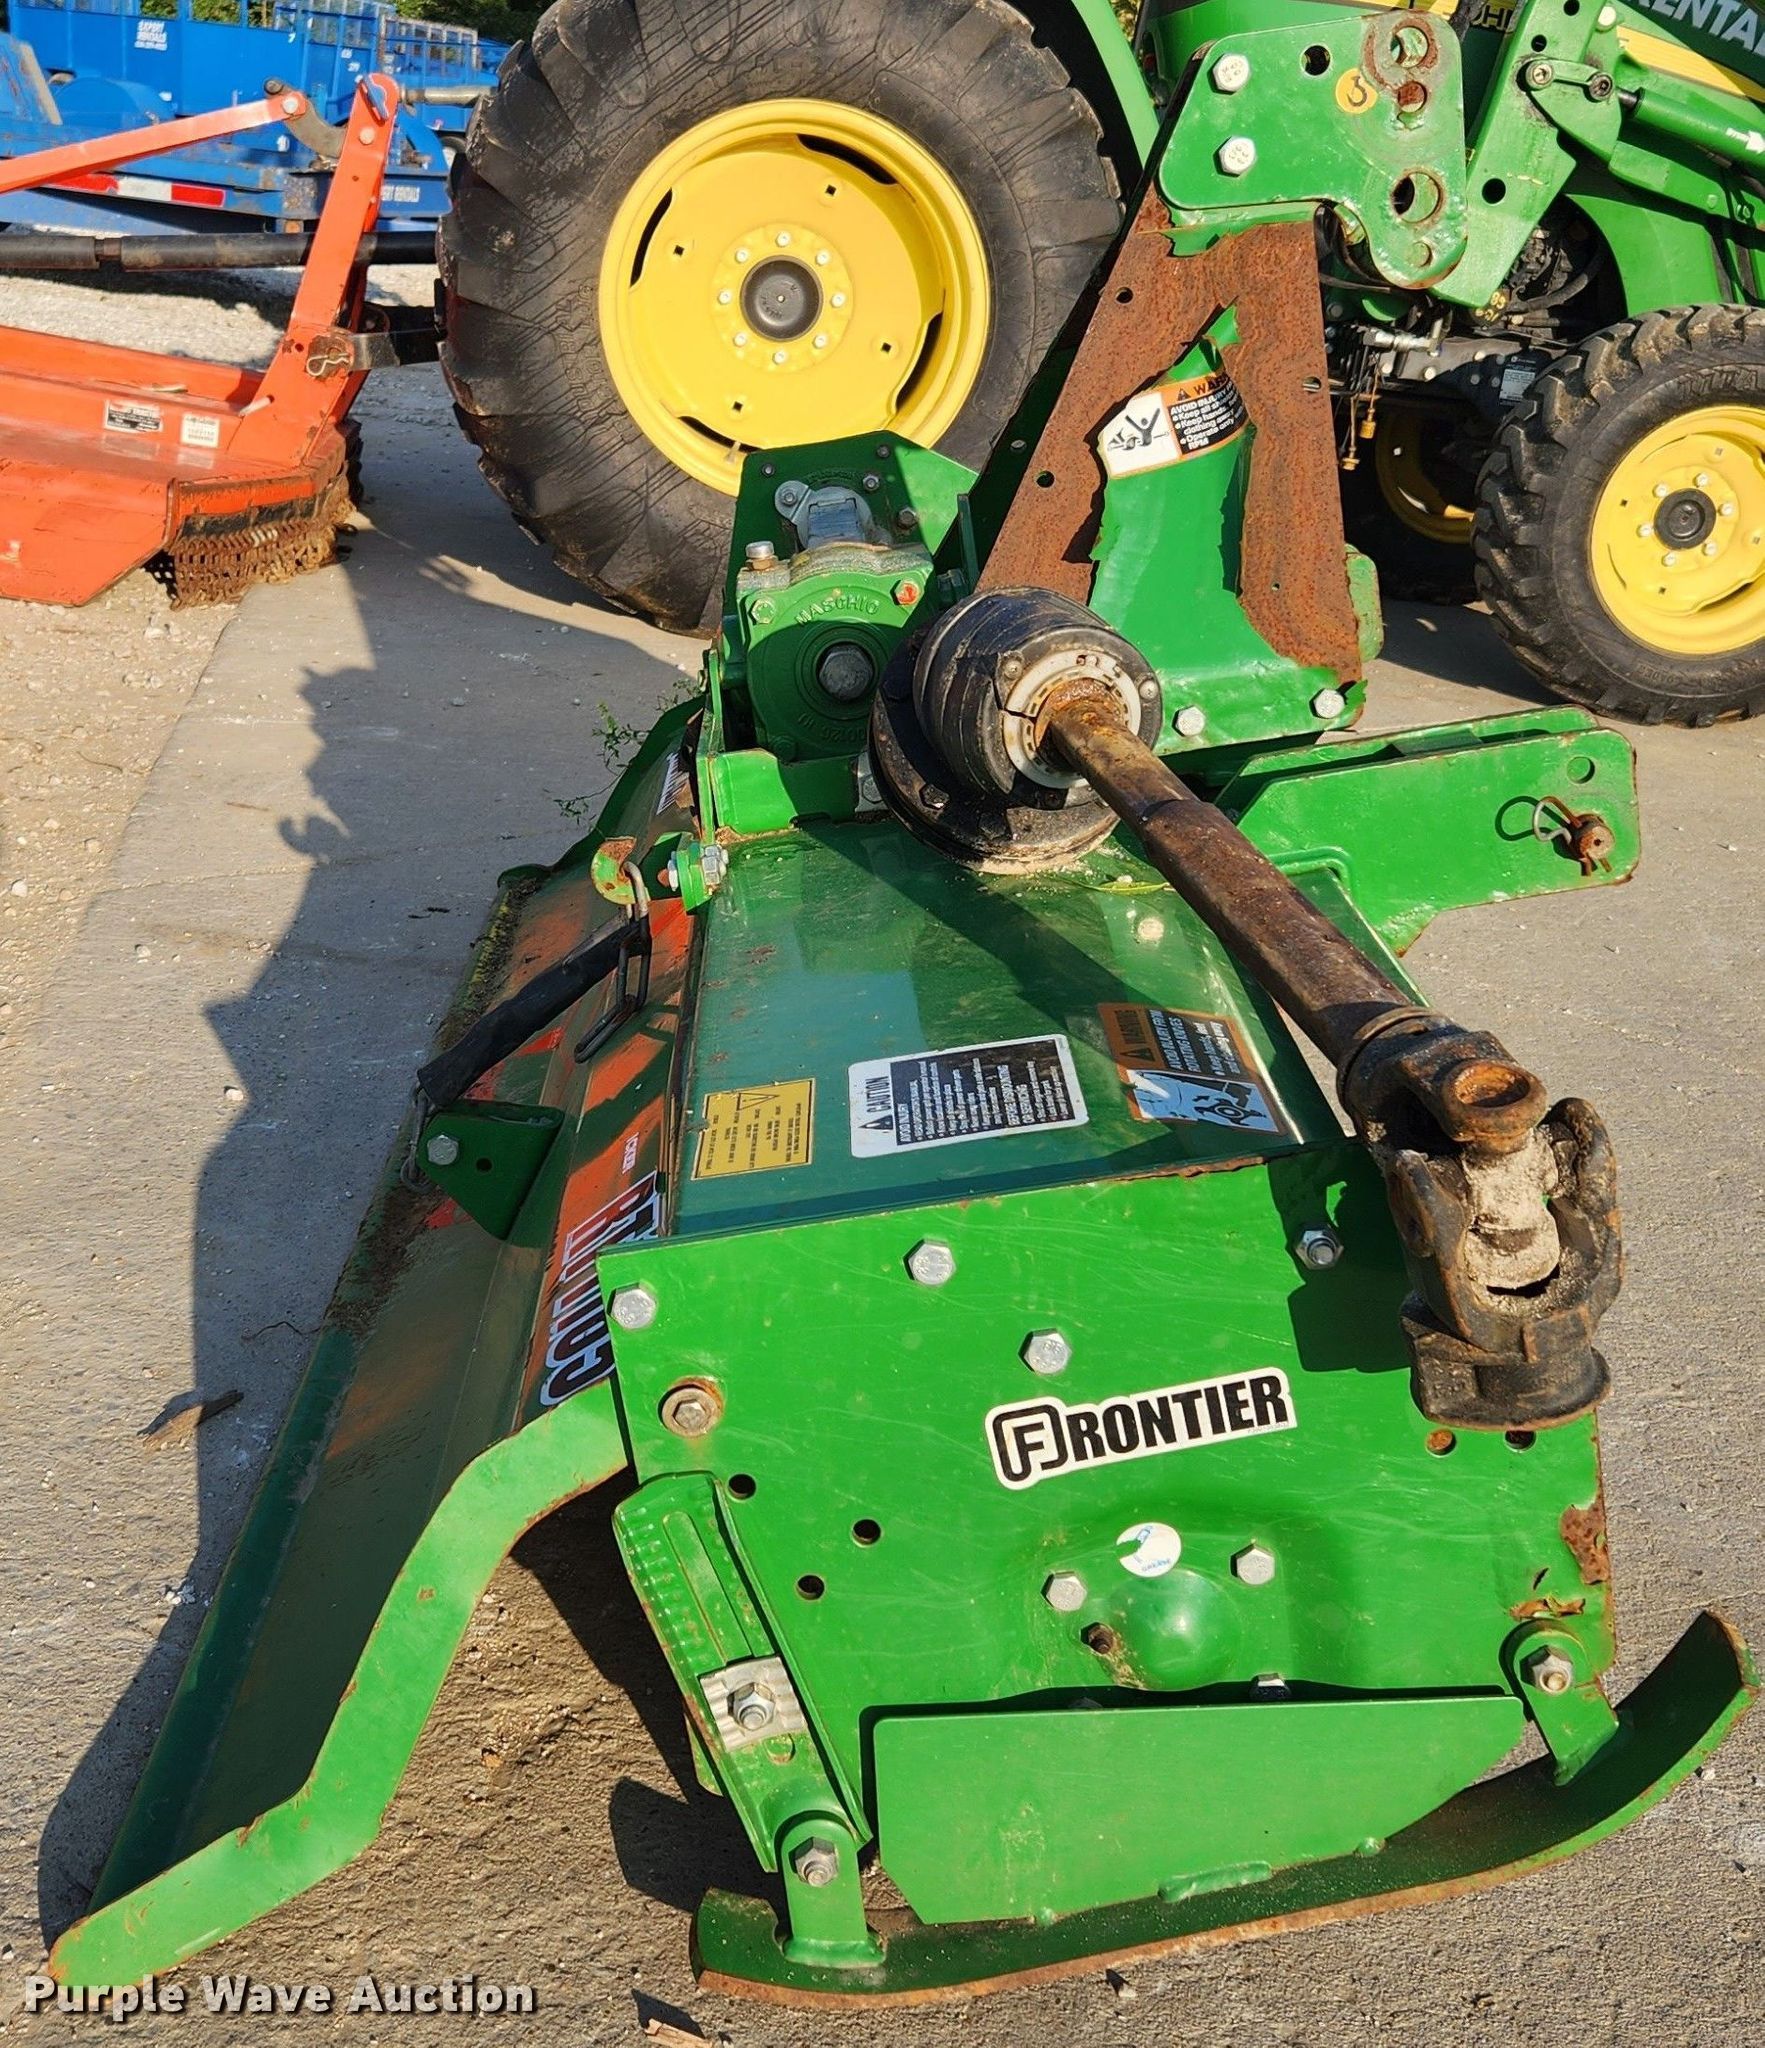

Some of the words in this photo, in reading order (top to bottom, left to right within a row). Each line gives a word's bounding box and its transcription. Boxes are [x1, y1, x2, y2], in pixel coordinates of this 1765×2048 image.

[1632, 0, 1765, 57] NTA
[794, 594, 880, 626] MASCHIO
[865, 1075, 890, 1113] CAUTION
[991, 1374, 1289, 1483] FRONTIER
